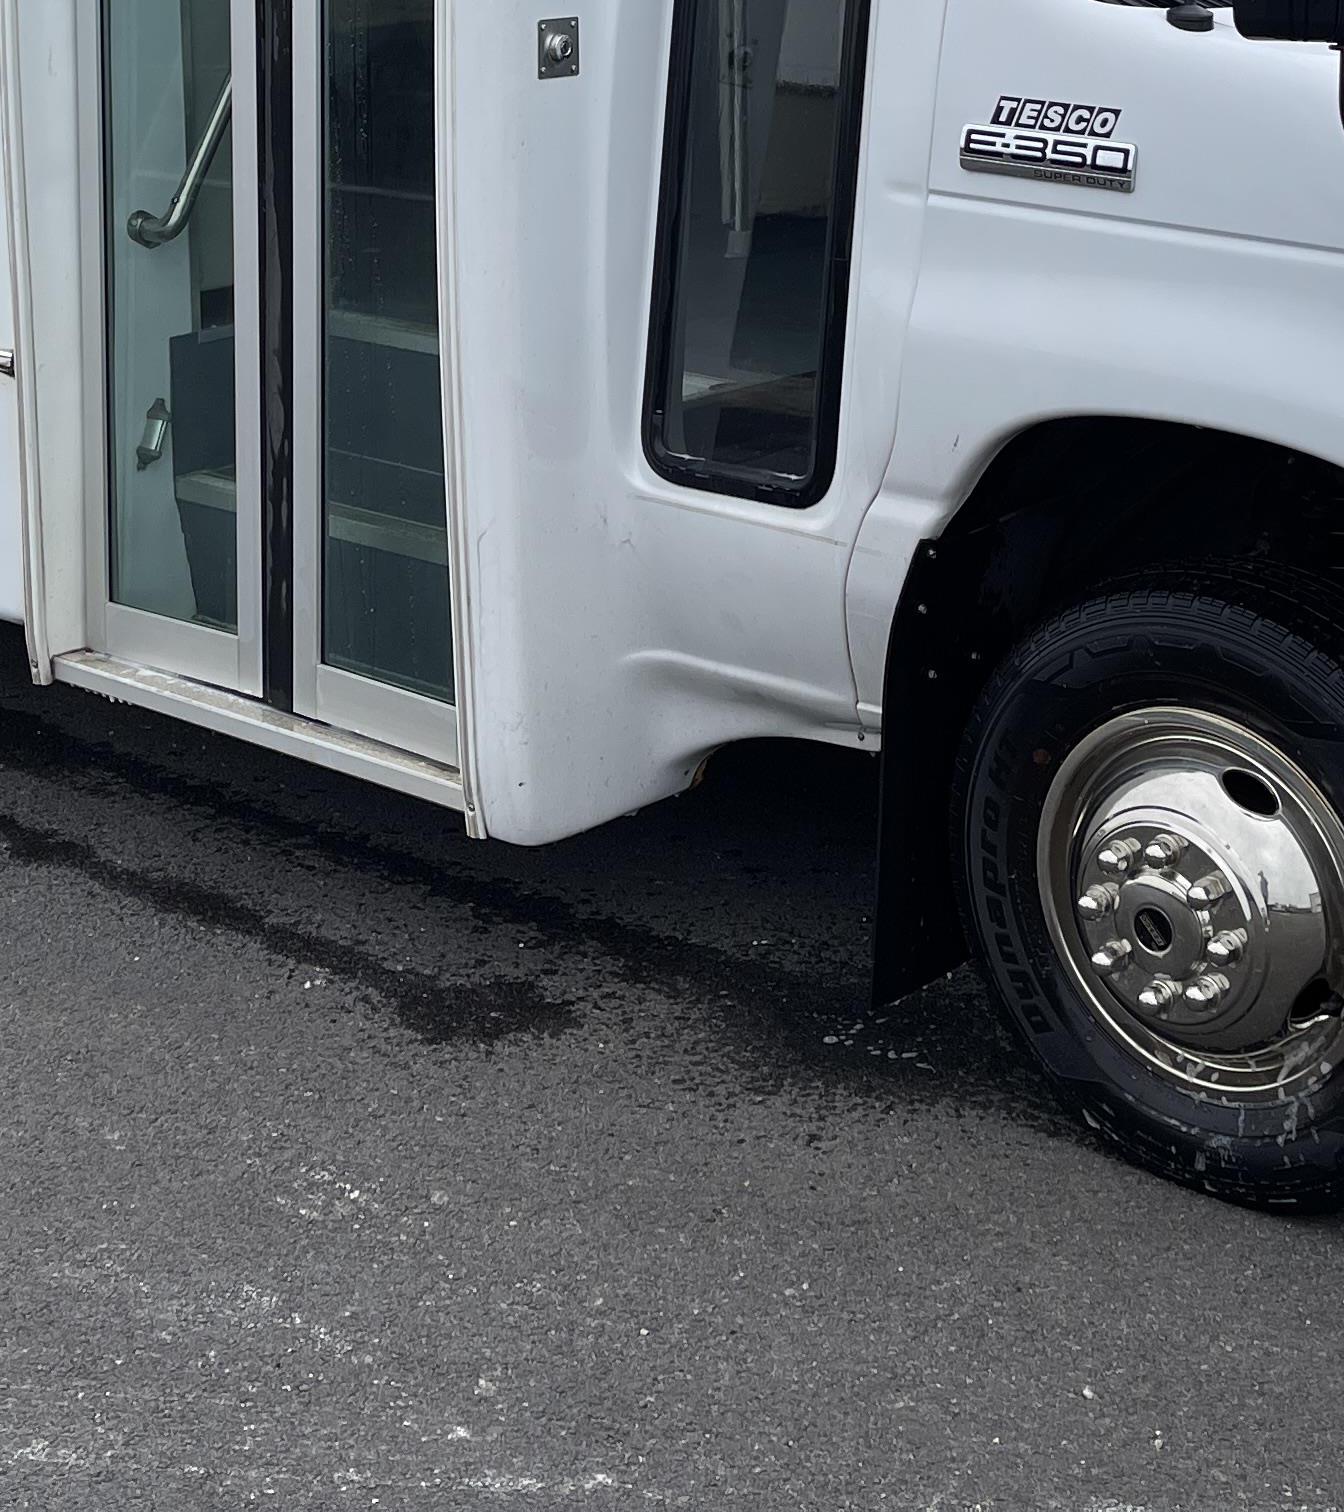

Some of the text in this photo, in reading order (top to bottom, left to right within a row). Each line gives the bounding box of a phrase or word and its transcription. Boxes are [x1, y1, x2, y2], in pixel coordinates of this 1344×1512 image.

[998, 99, 1116, 134] TESCO
[964, 128, 1130, 174] E-350
[1034, 169, 1126, 189] SUPER DUTY
